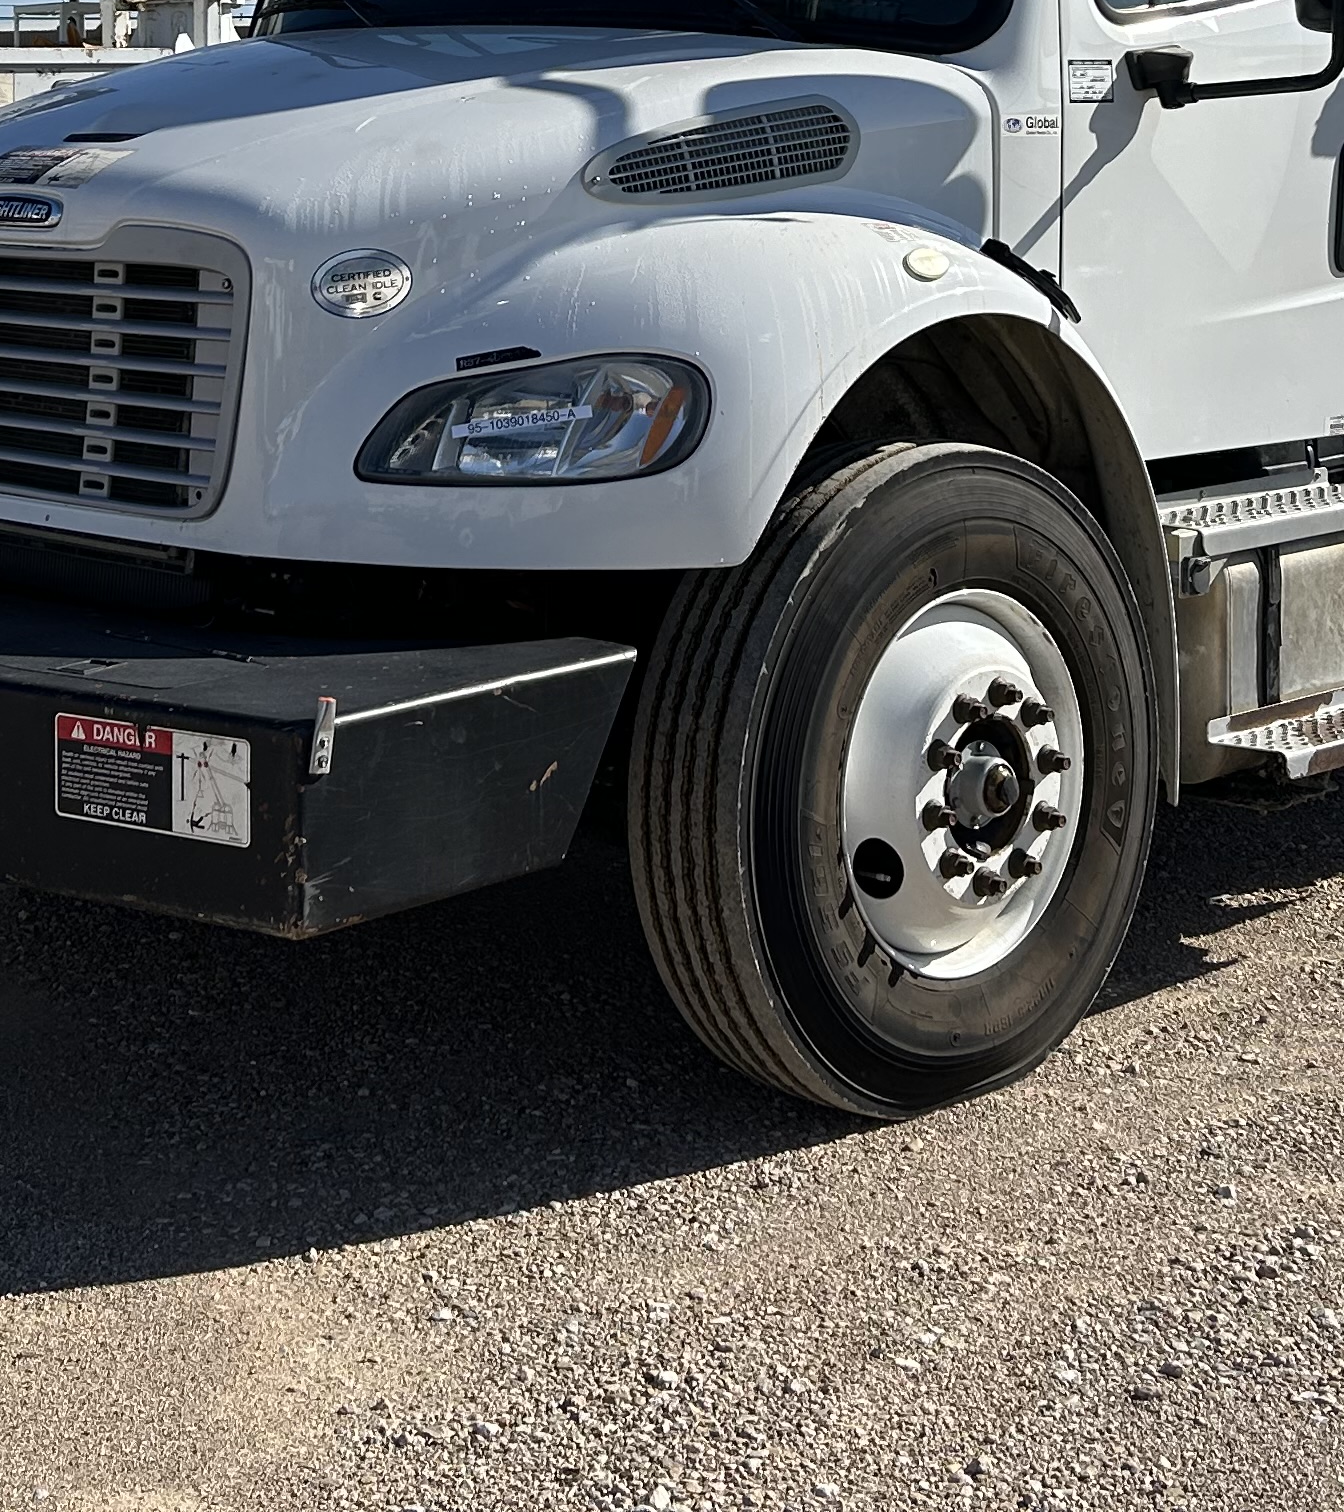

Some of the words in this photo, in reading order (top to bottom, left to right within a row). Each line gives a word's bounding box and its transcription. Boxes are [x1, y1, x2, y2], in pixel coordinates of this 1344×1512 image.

[1026, 116, 1060, 129] Global
[331, 268, 392, 283] CERTIFIED
[326, 282, 367, 295] CLEAN
[371, 278, 399, 289] IDLE
[467, 408, 577, 435] 95-1039018450-A
[117, 750, 142, 761] HAZARD
[83, 803, 110, 817] KEEP
[112, 807, 147, 824] CLEAR
